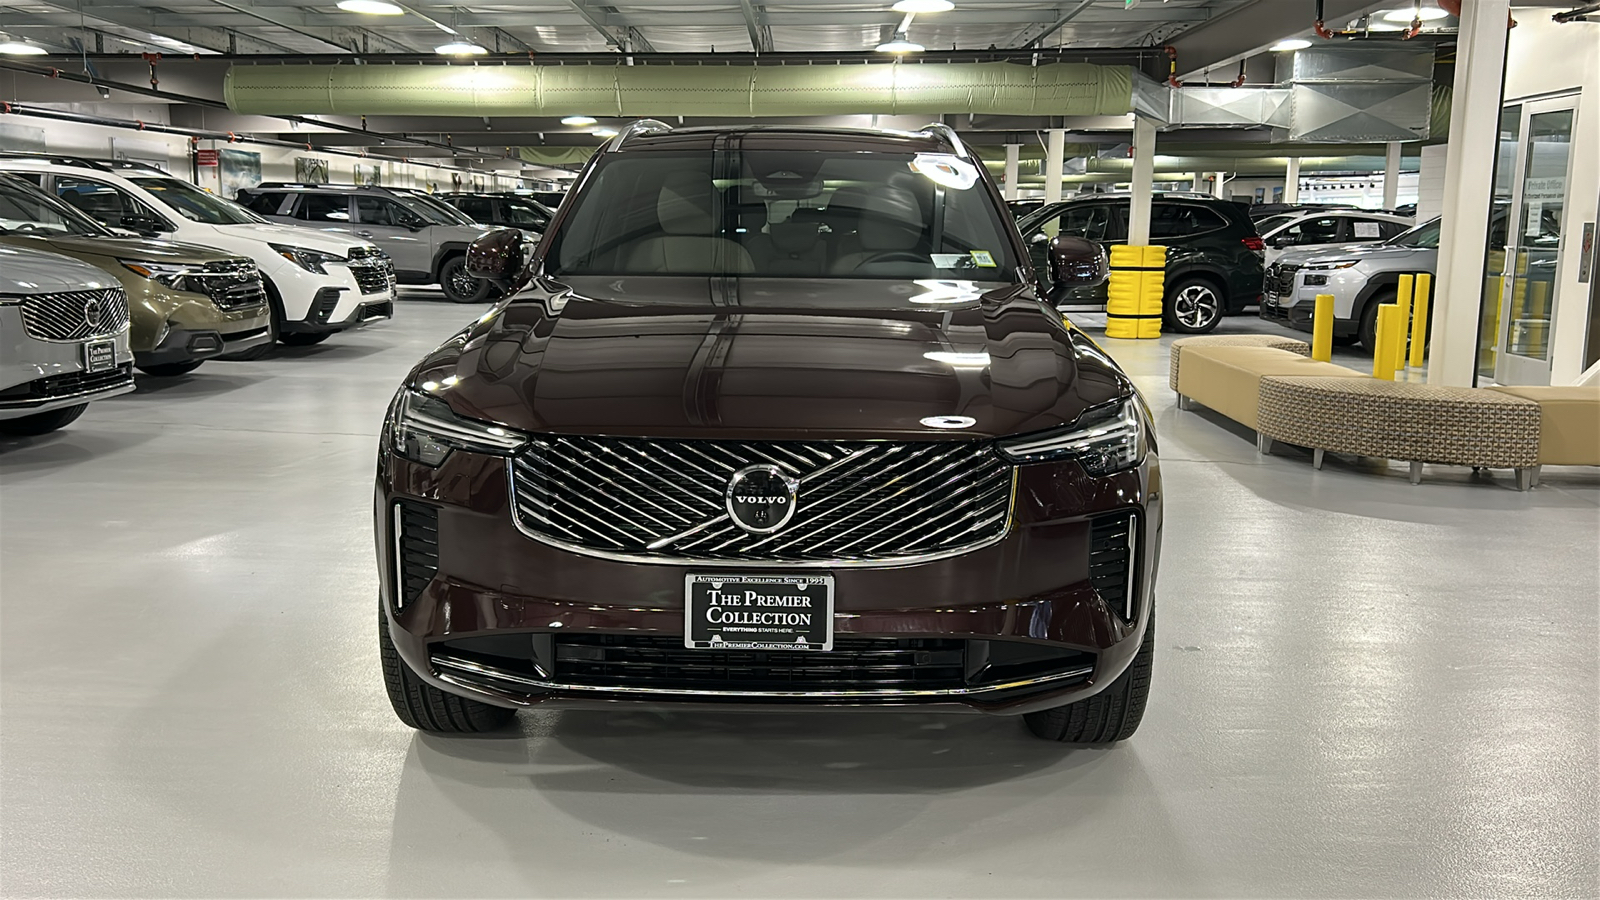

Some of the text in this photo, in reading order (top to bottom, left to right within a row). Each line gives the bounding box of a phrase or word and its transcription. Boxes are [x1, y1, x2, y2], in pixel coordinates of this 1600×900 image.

[736, 495, 787, 504] VOLVO
[805, 577, 824, 585] 1995
[706, 590, 812, 608] THE PREMIER
[706, 606, 812, 626] COLLECTION
